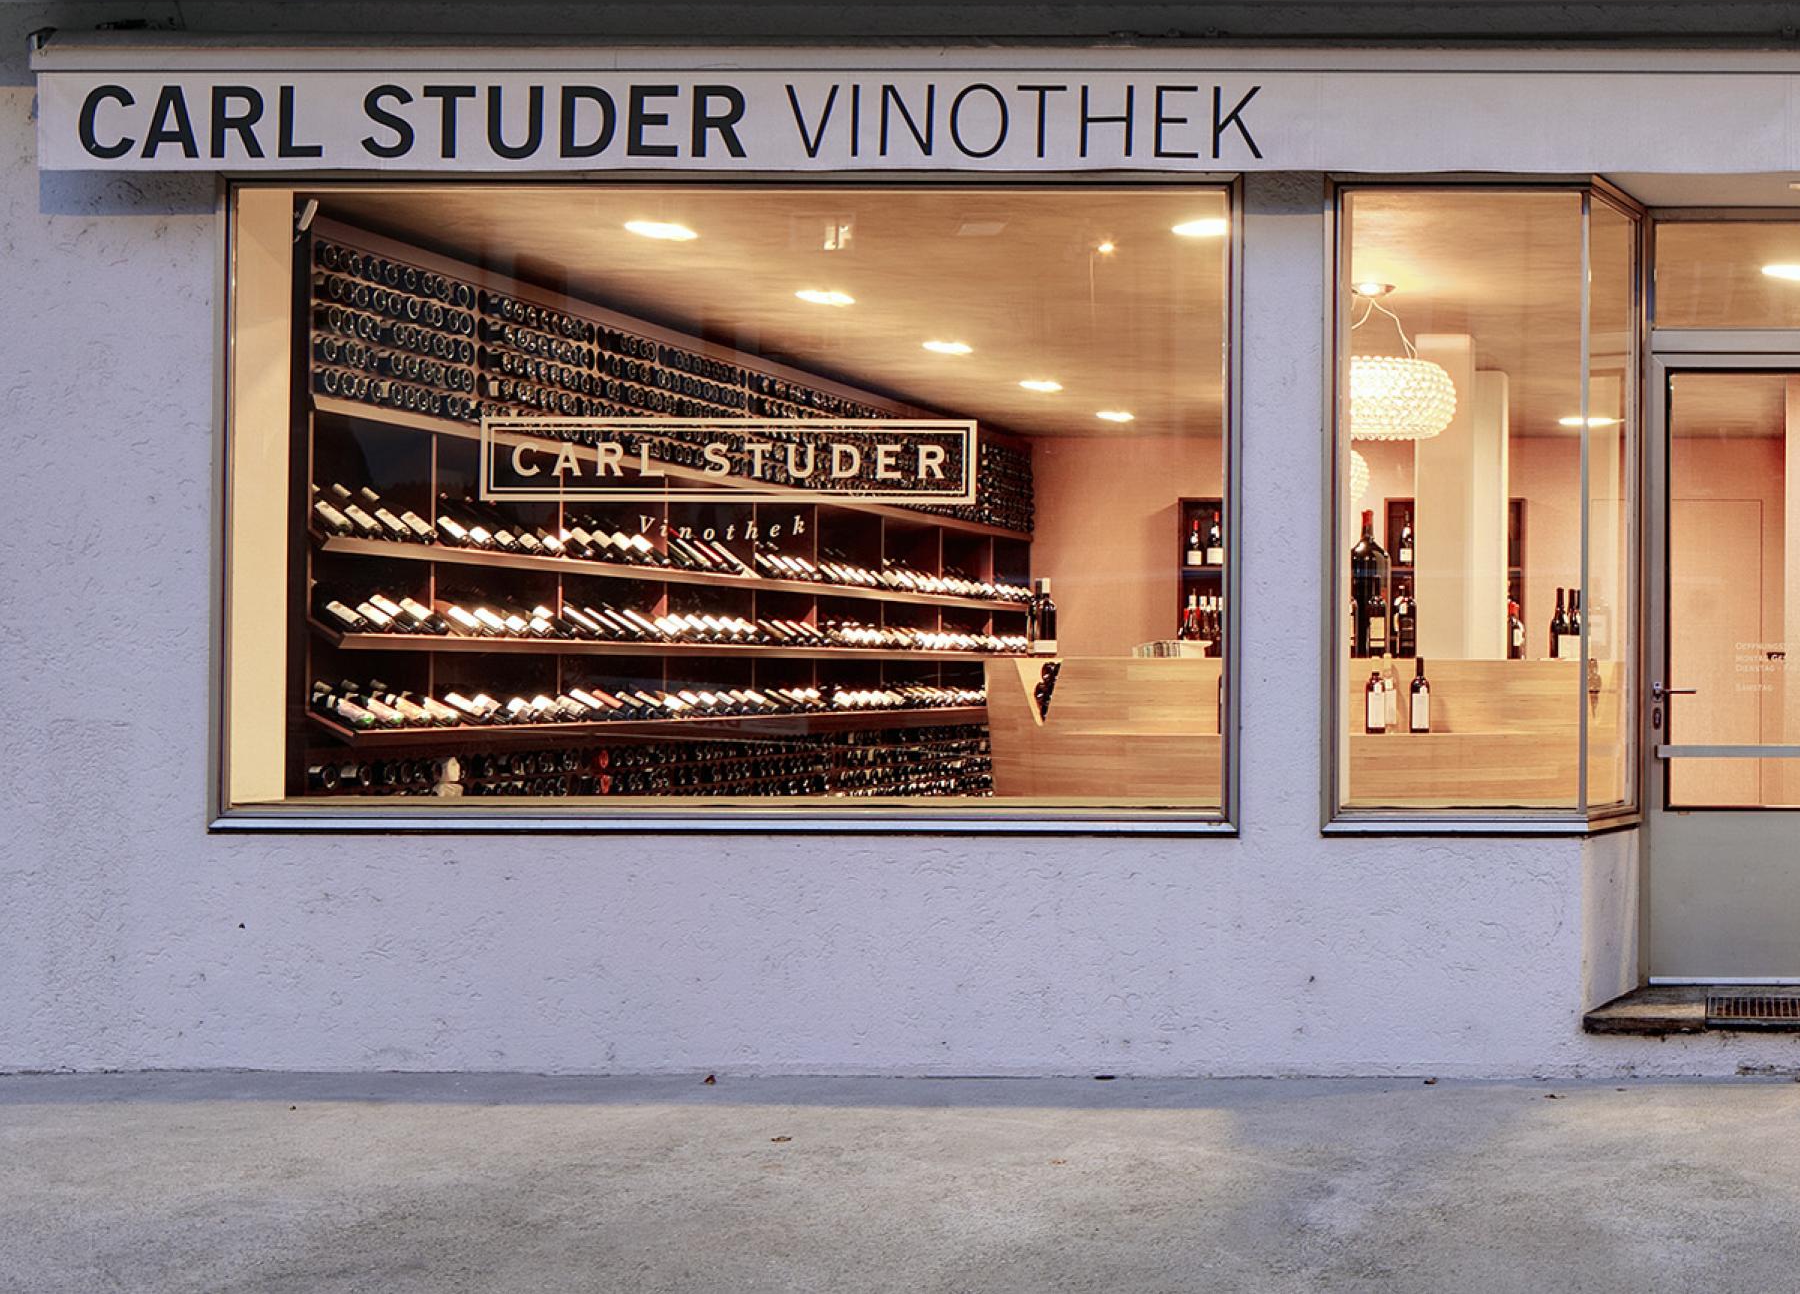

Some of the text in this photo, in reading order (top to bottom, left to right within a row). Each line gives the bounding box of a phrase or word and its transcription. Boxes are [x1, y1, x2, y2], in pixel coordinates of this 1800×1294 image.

[78, 82, 1264, 160] CARL STUDER VINOTHEK
[511, 441, 946, 480] CARL STUDER
[638, 514, 806, 542] Vinothek
